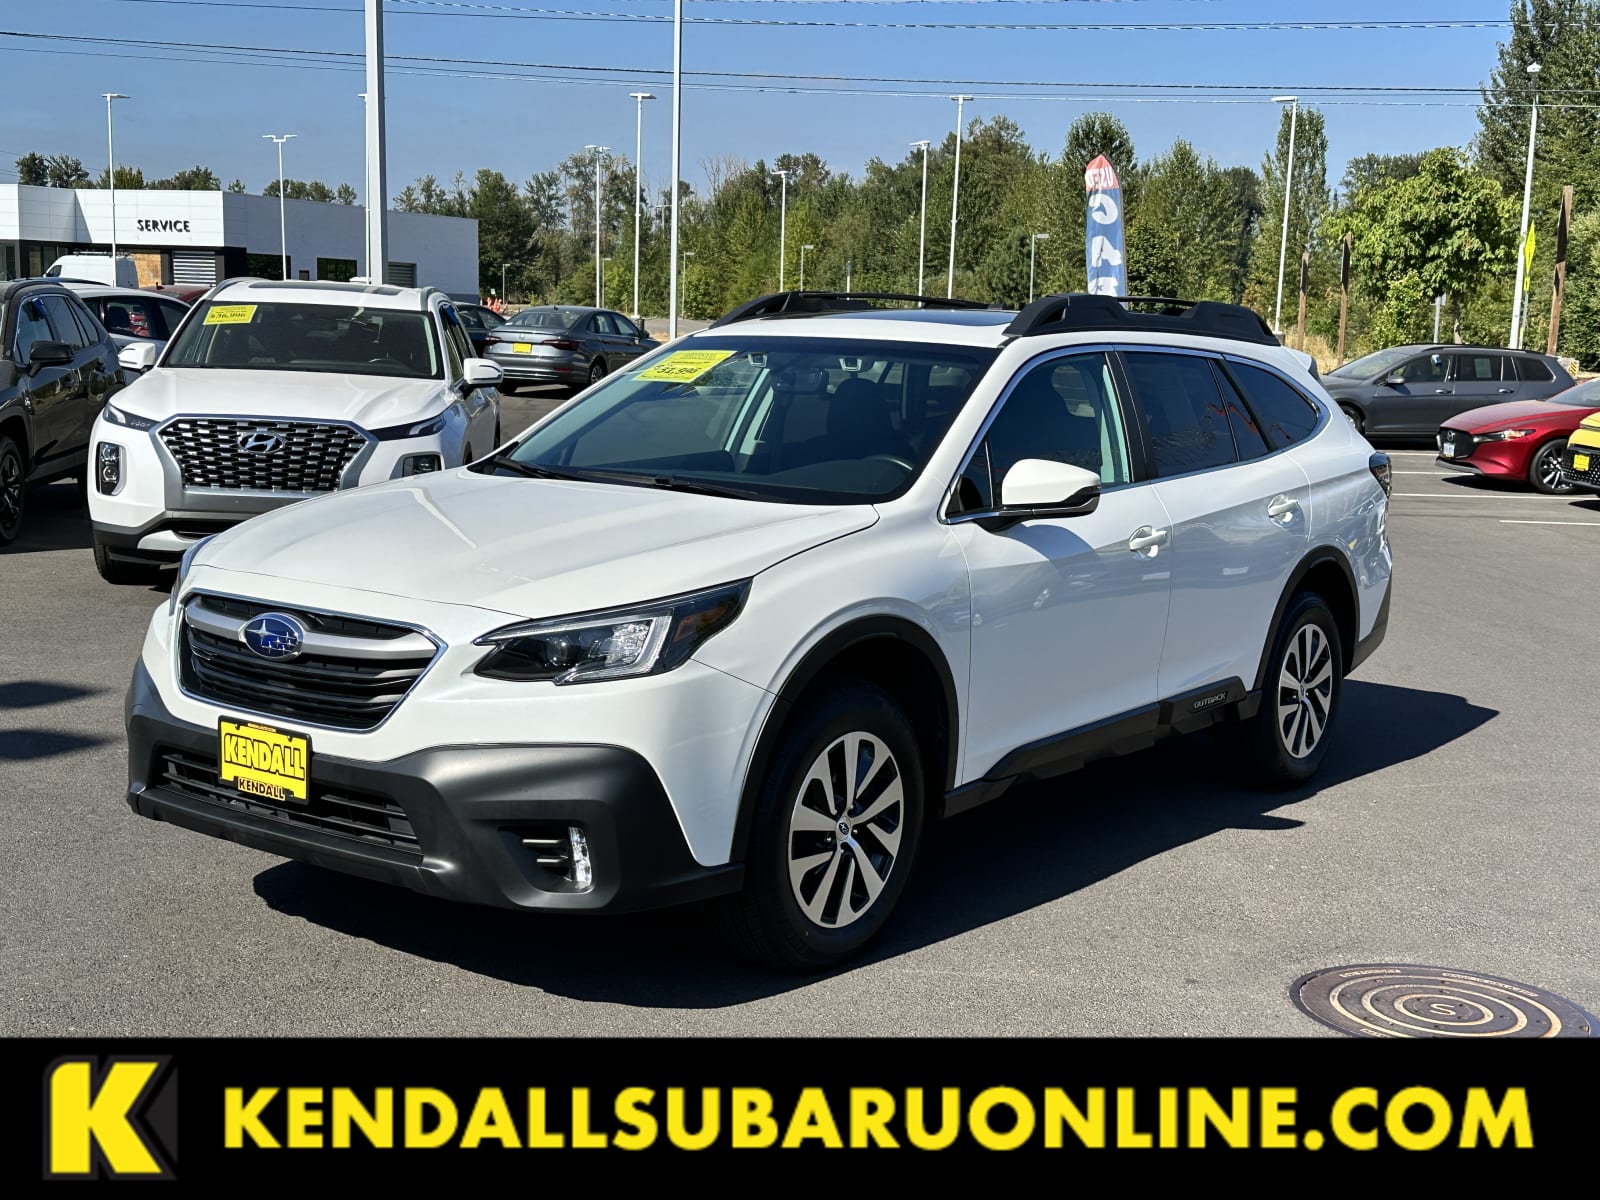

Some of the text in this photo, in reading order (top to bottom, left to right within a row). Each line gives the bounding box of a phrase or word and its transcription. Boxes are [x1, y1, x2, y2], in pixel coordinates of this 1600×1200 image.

[136, 219, 191, 233] SERVICE
[1193, 691, 1226, 709] OUTBACK
[224, 732, 305, 782] KENDALL
[238, 778, 285, 800] KENDALL
